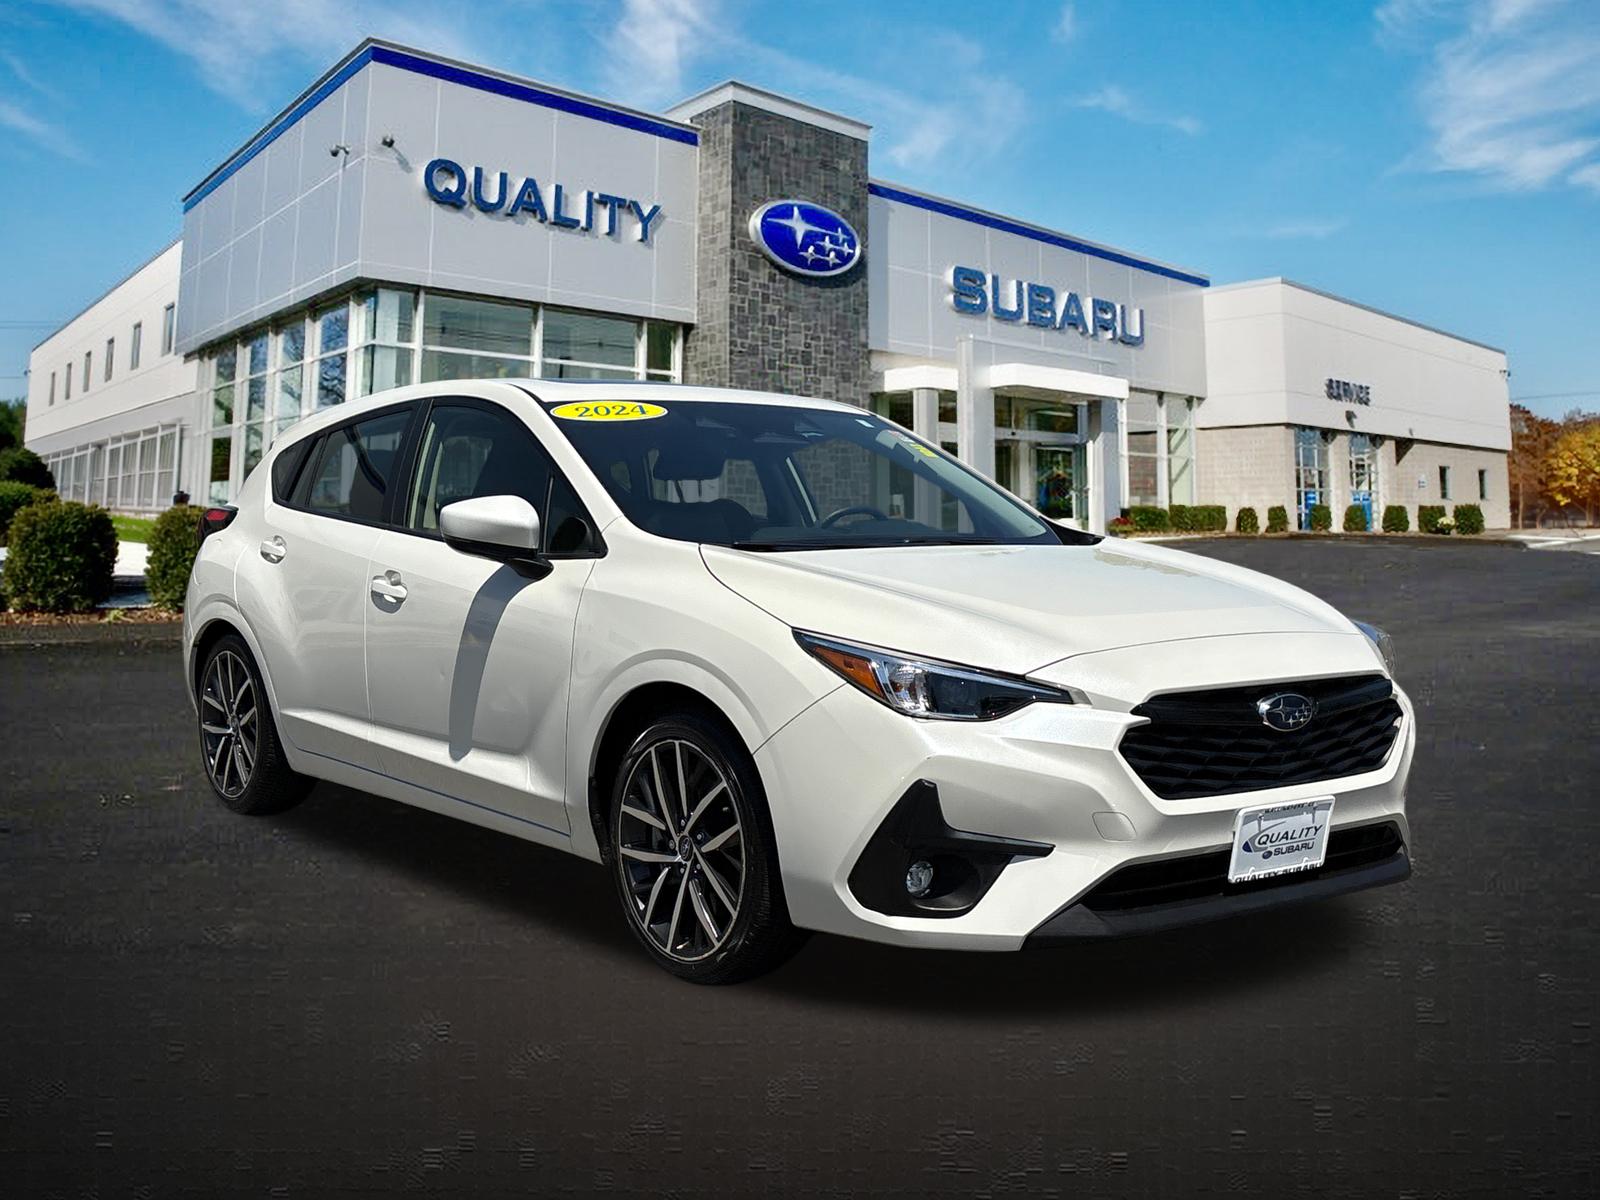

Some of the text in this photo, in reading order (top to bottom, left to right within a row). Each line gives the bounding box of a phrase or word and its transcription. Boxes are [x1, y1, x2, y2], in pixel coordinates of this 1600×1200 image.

[424, 158, 661, 242] QUALITY
[951, 265, 1145, 346] SUBARU
[575, 404, 648, 418] 2024
[1257, 825, 1322, 846] QUALITY
[1273, 841, 1315, 856] SUBARU
